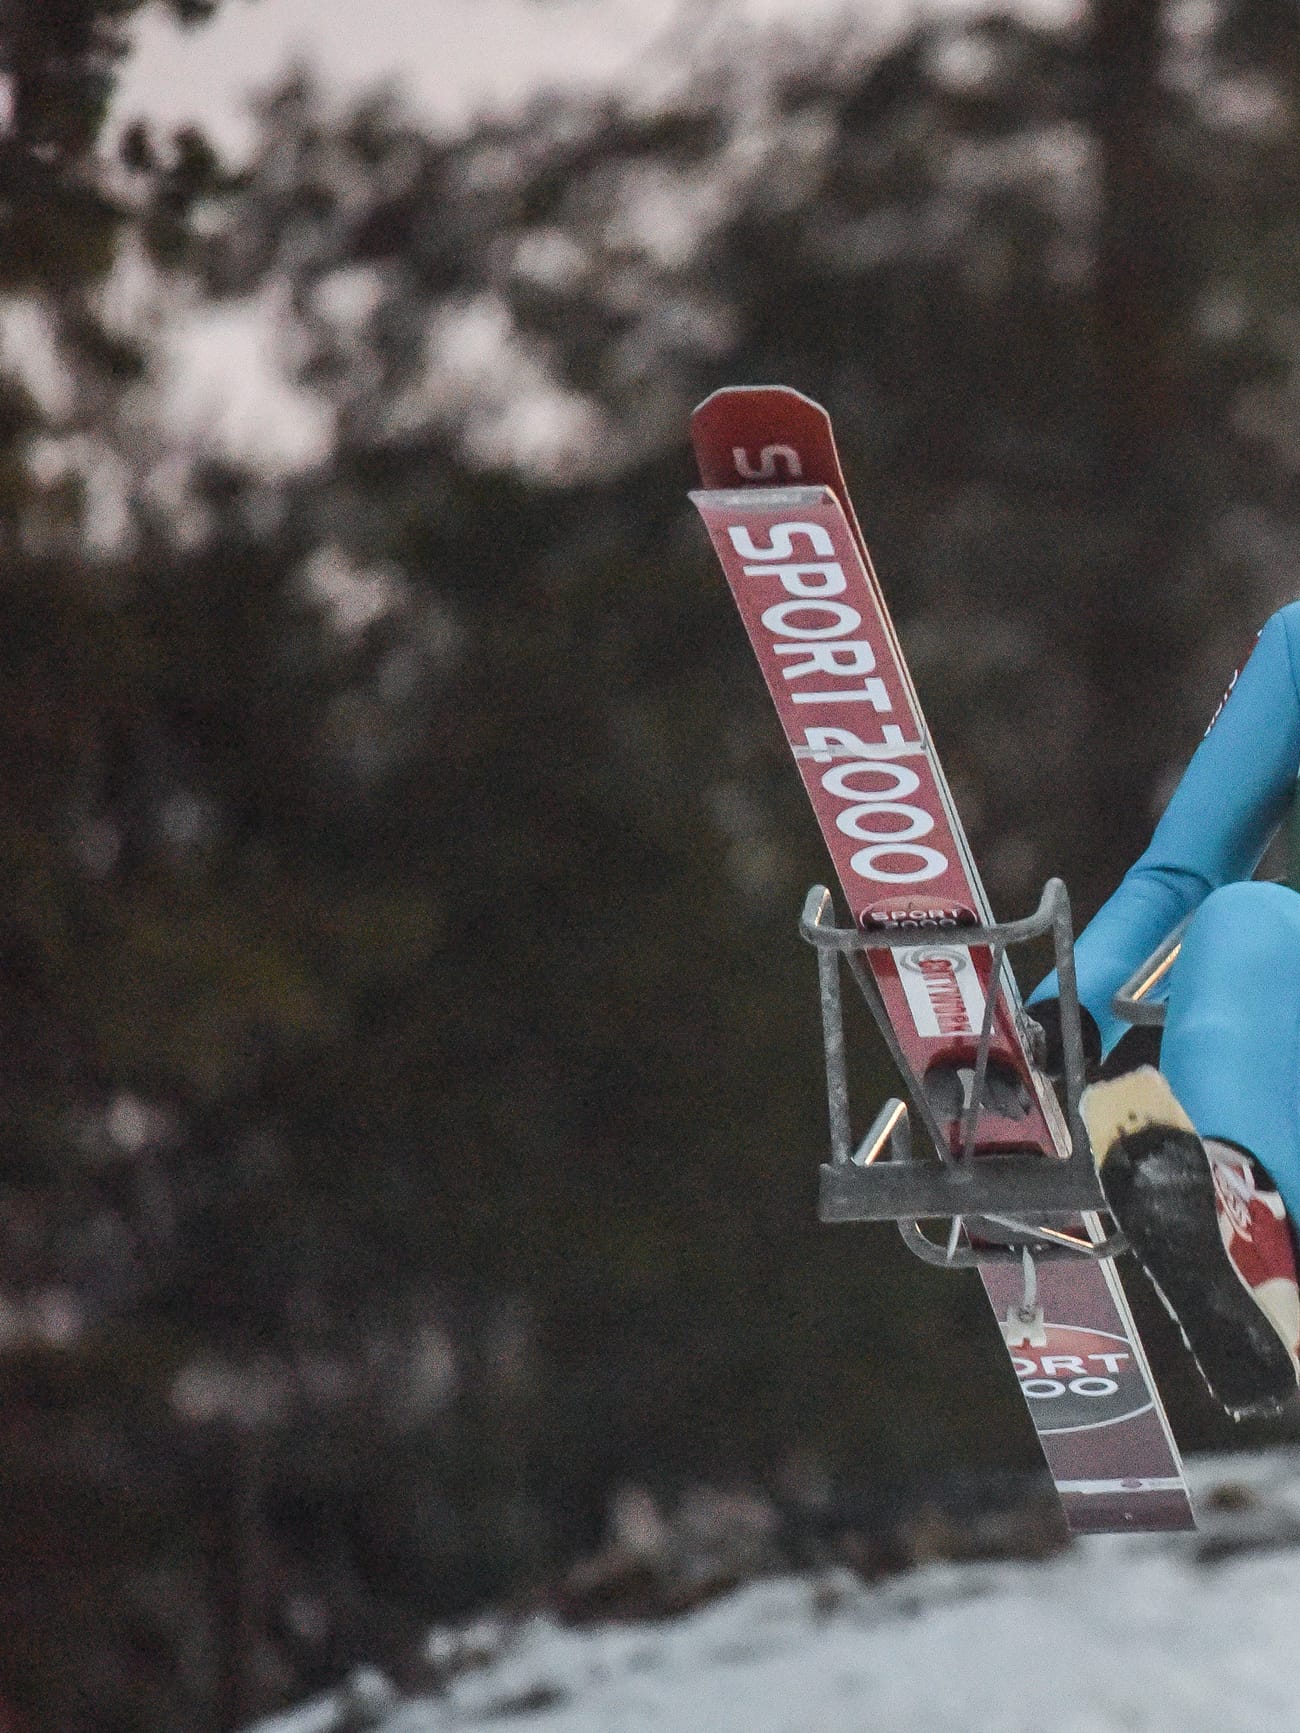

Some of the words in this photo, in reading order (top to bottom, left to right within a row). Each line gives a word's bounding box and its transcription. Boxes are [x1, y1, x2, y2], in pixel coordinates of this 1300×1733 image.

[728, 522, 892, 715] SPORT
[804, 724, 949, 884] 2000
[871, 908, 960, 921] SPORT
